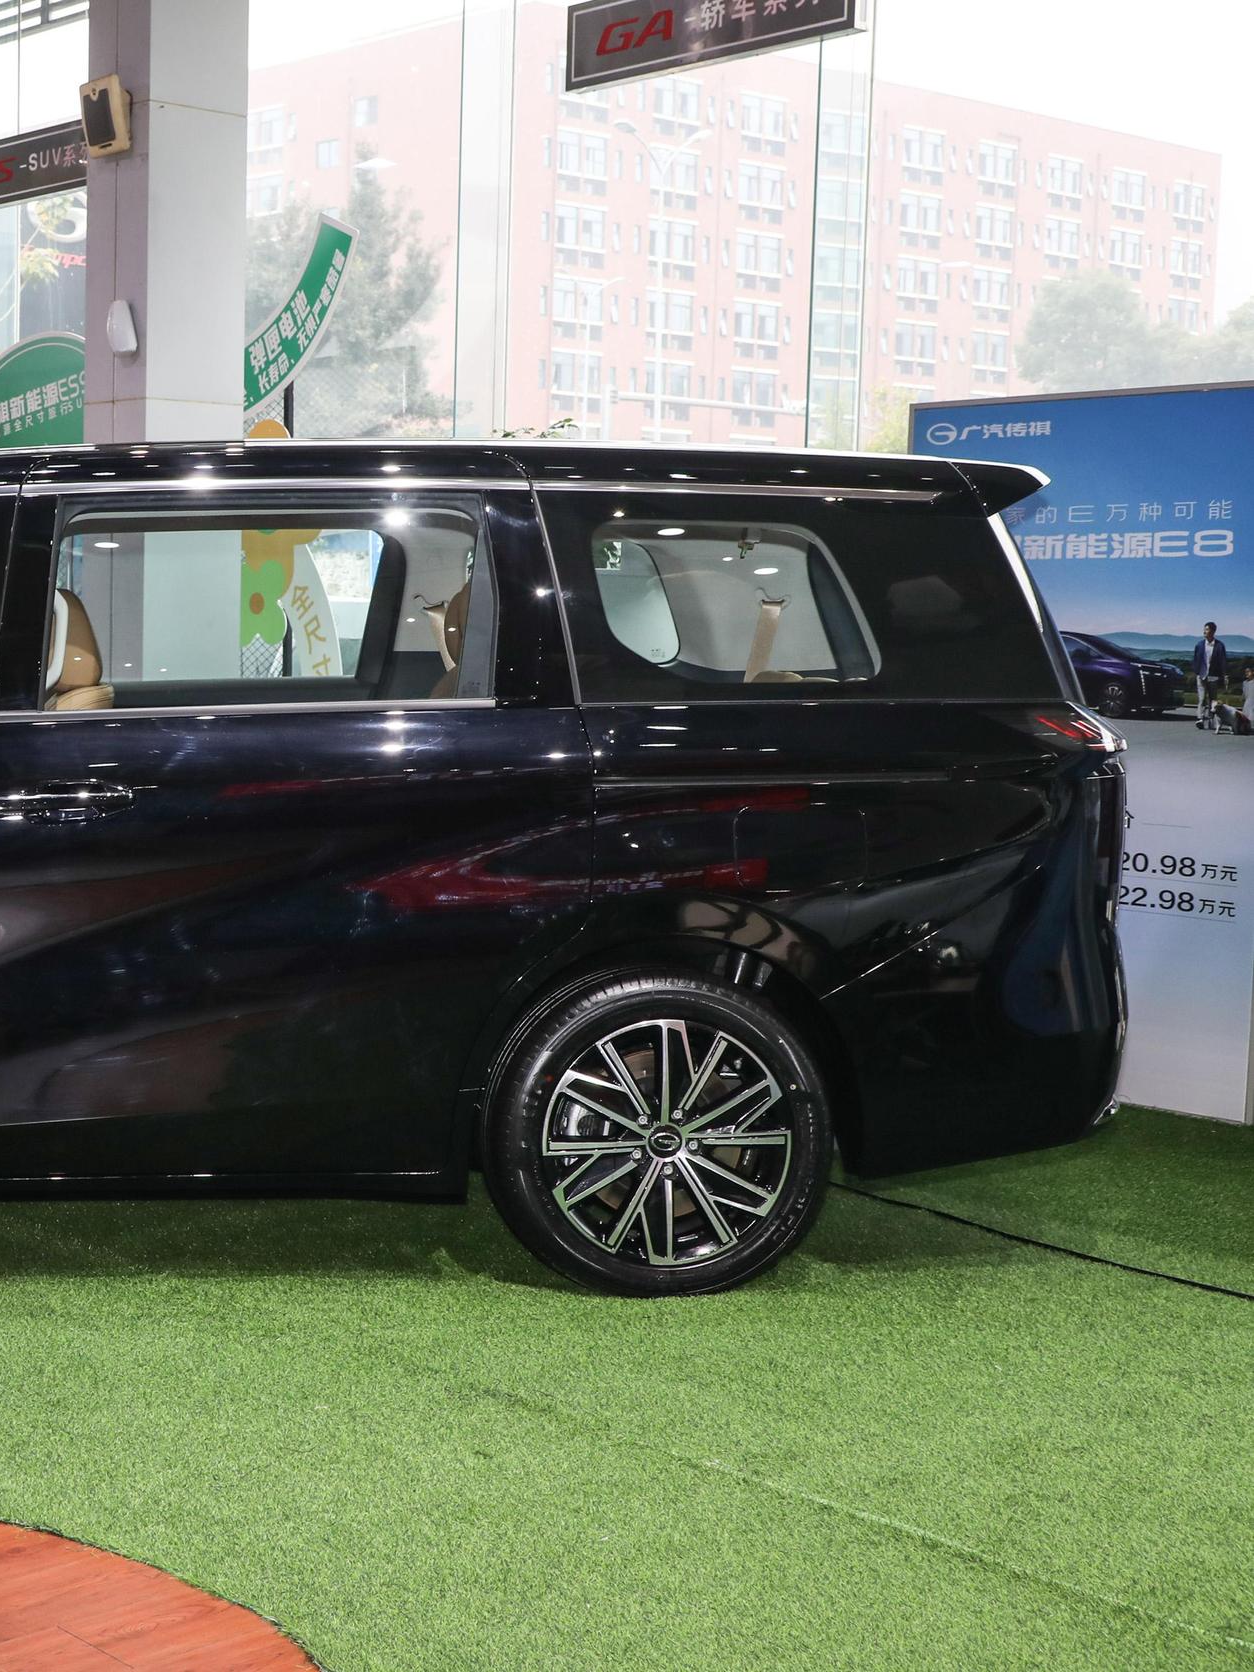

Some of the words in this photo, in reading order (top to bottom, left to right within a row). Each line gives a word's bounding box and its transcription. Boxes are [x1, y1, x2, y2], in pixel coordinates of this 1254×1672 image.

[248, 289, 310, 375] 弹匣电池
[959, 421, 1051, 440] 广汽传祺
[1016, 529, 1234, 560] 新能源E8
